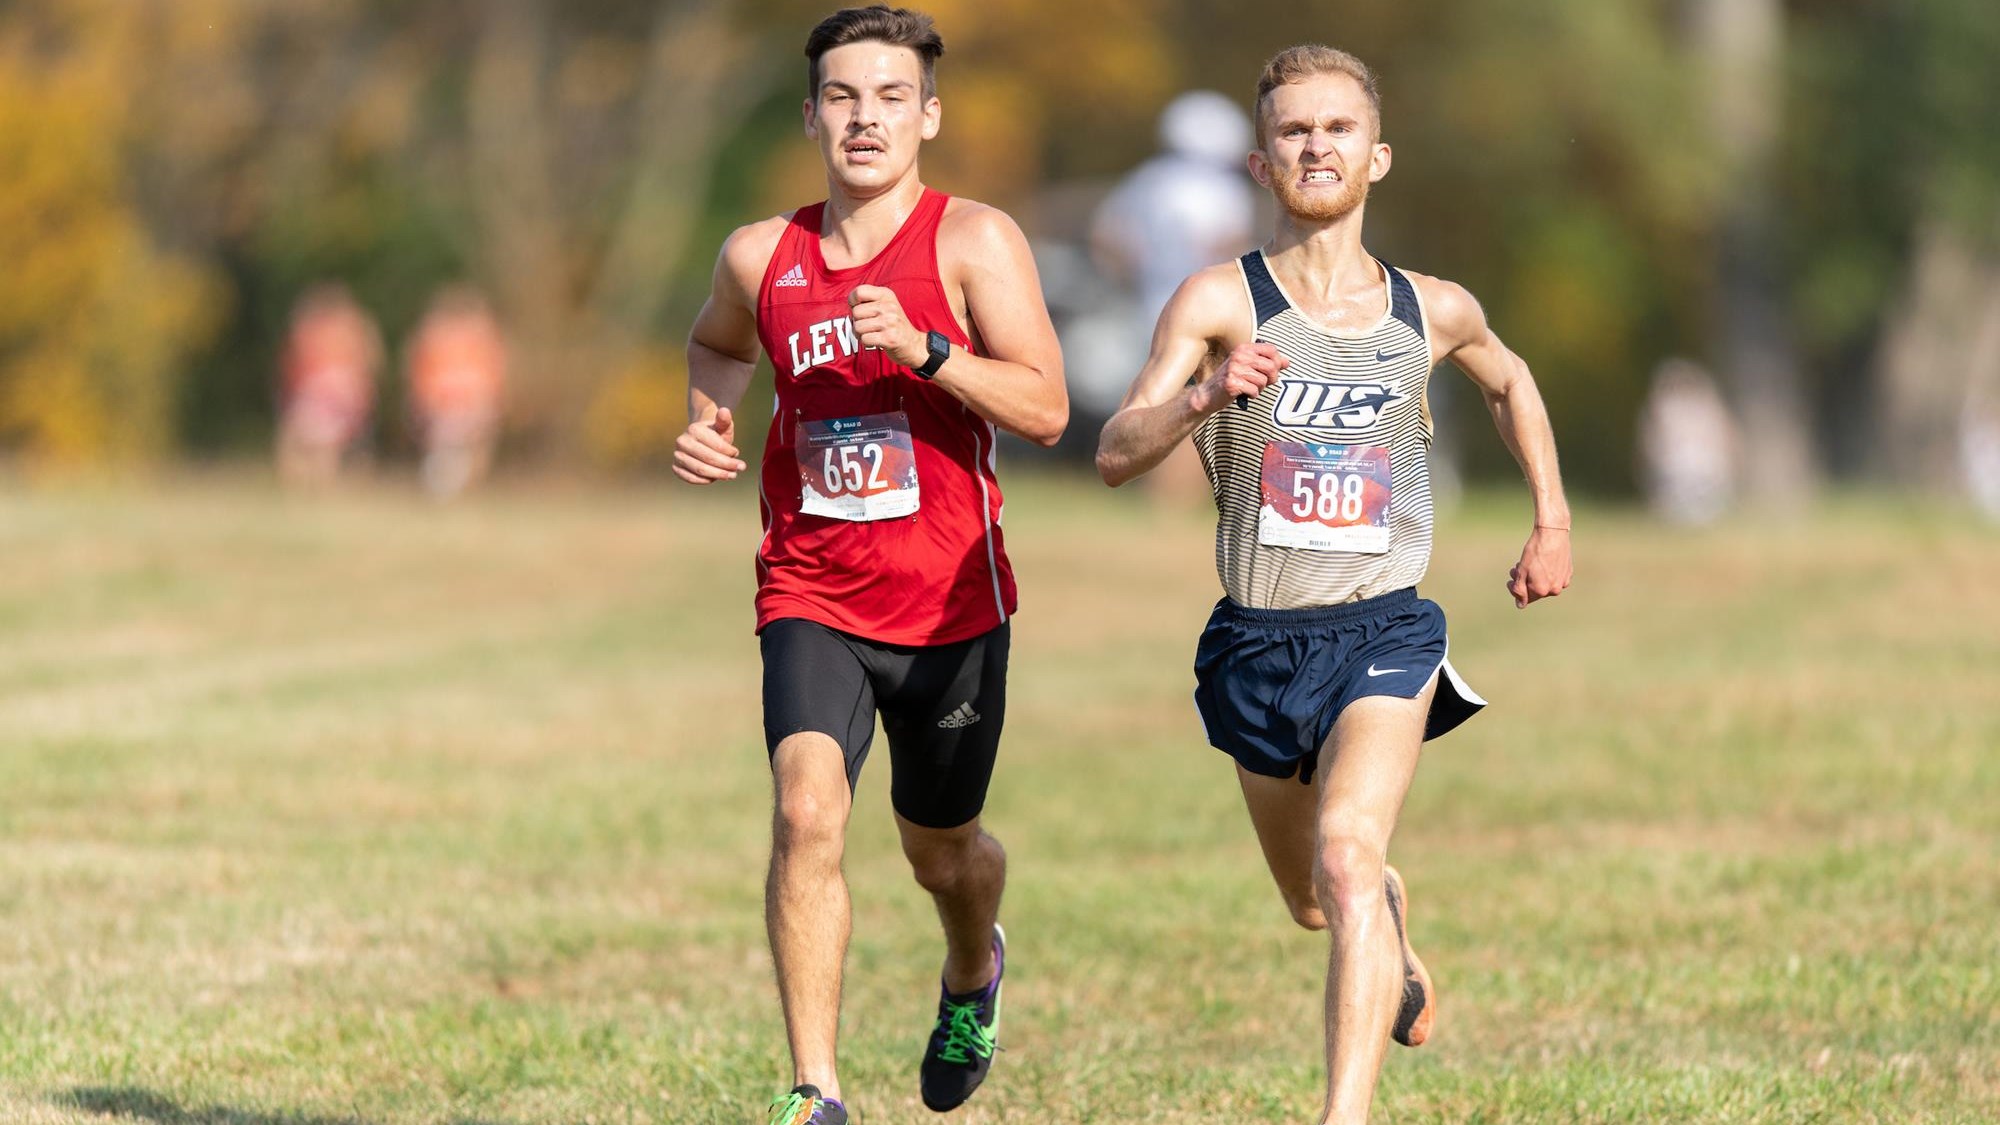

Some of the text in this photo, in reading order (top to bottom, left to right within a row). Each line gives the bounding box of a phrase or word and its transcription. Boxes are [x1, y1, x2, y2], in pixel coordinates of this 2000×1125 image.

[775, 277, 807, 287] adidas
[788, 315, 884, 377] LEW
[1273, 379, 1402, 429] UIS
[823, 443, 888, 493] 652
[1292, 470, 1364, 521] 588
[937, 713, 981, 729] adidas
